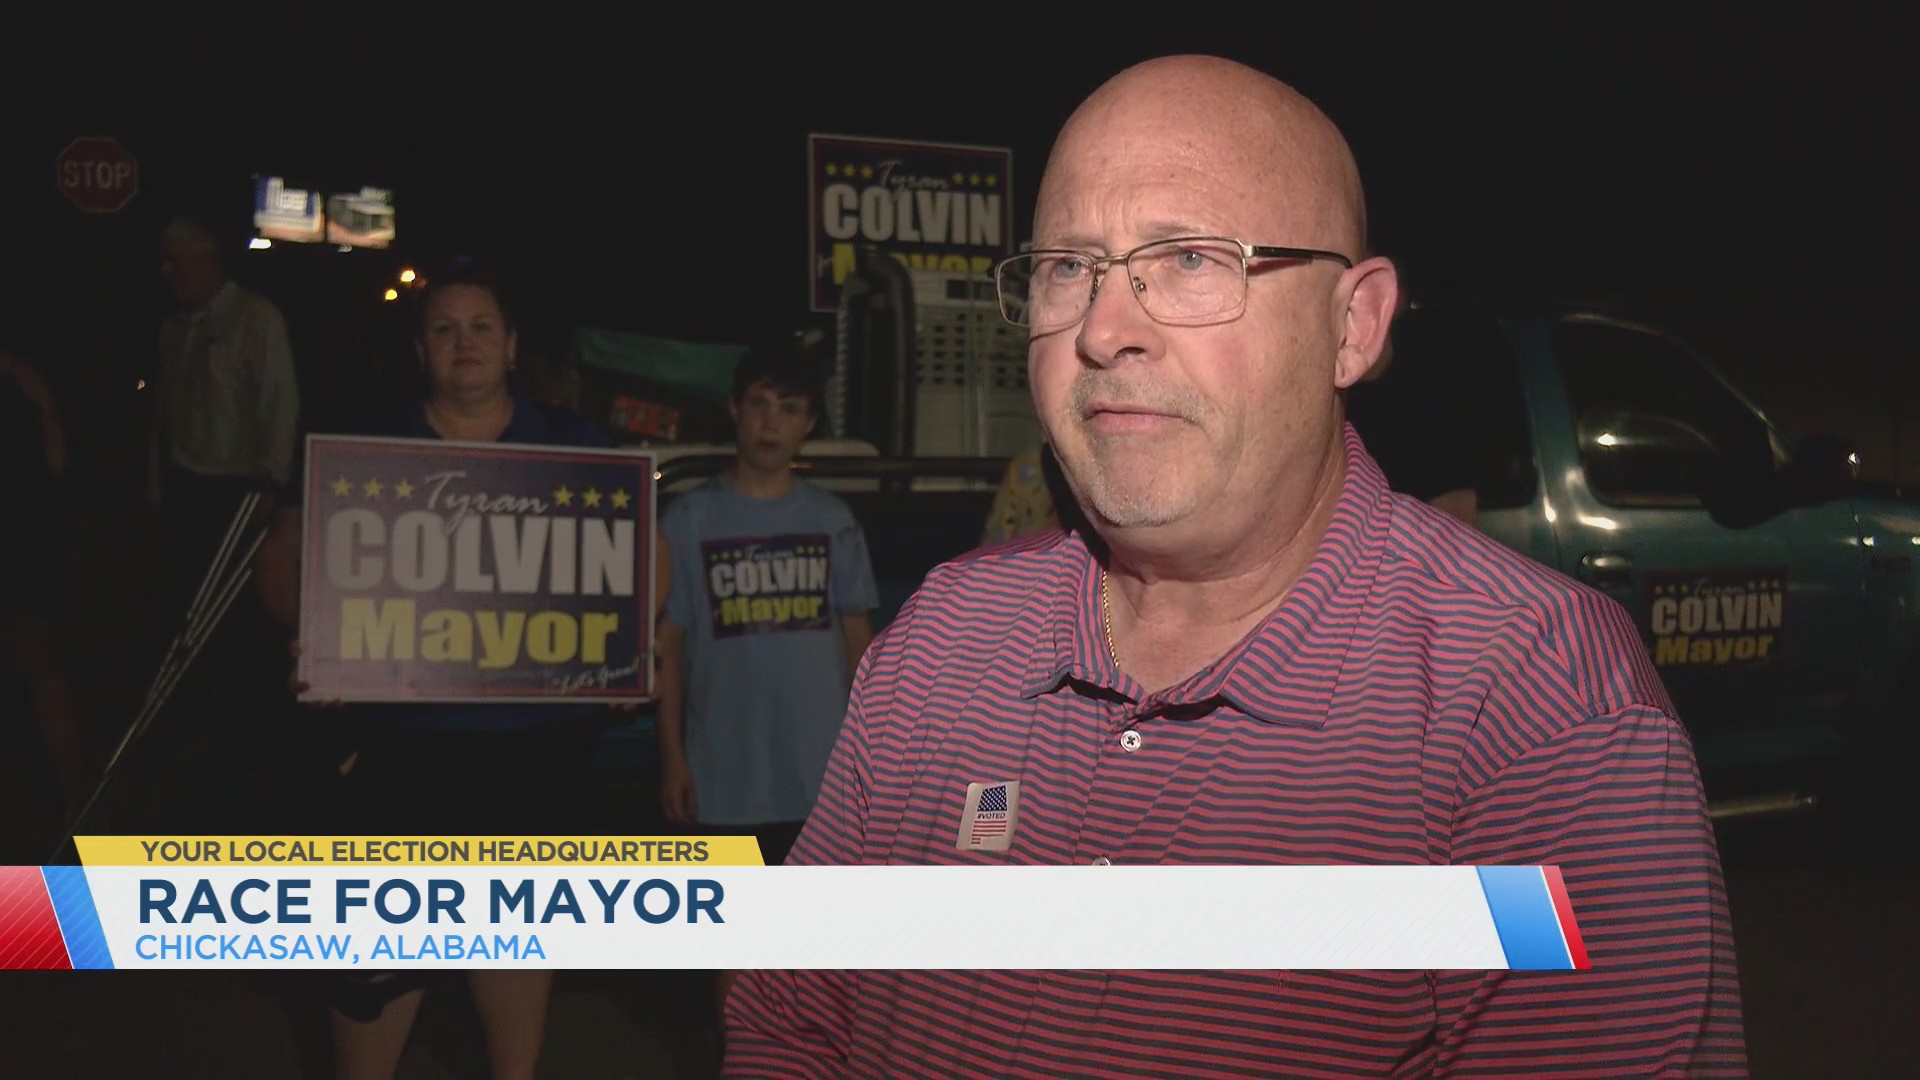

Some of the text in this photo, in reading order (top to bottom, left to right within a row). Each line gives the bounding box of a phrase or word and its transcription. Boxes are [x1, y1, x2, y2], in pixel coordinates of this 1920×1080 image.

[63, 160, 131, 190] STOP
[823, 183, 1001, 247] COLVIN
[425, 470, 549, 535] Tyran
[326, 507, 635, 597] COLVIN
[711, 557, 828, 598] COLVIN
[719, 595, 824, 626] Mayor
[1652, 591, 1783, 635] COLVIN
[340, 597, 619, 669] Mayor
[1655, 635, 1774, 666] Mayor
